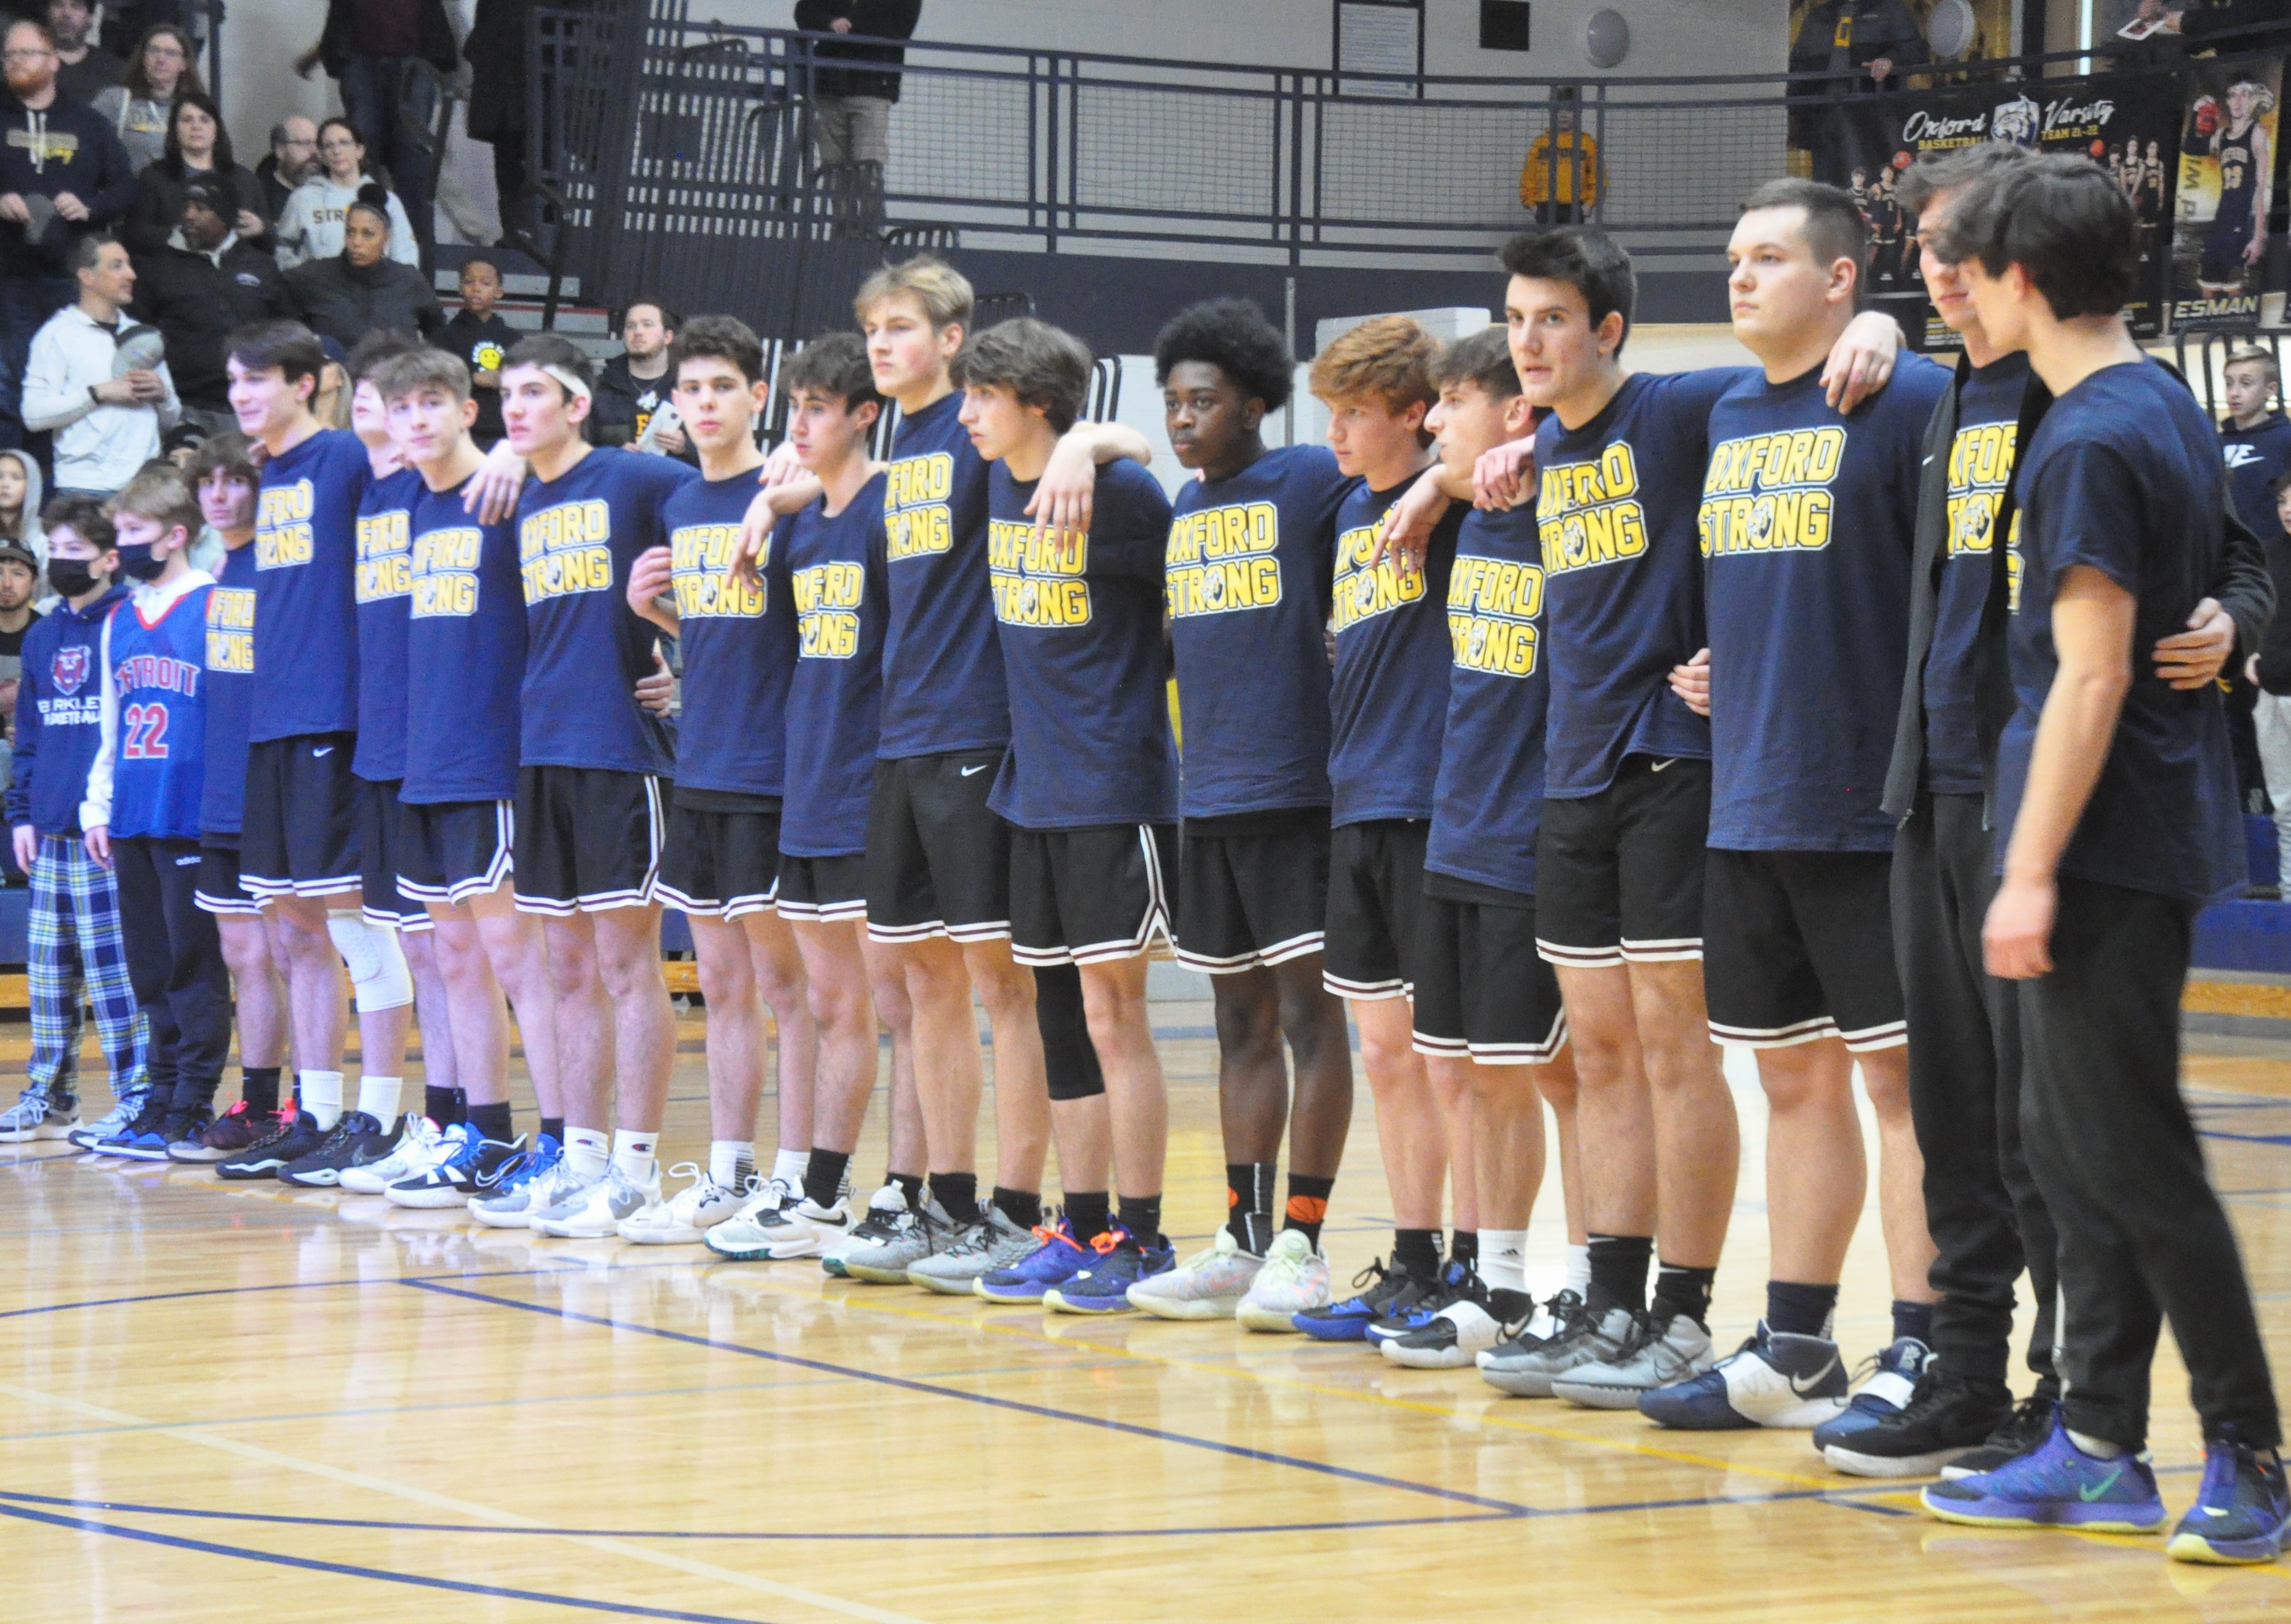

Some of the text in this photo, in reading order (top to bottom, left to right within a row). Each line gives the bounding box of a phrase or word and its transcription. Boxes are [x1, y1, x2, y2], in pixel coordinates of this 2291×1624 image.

[1903, 97, 2116, 142] Oxford Varsity
[1703, 426, 1847, 497] OXFORD
[1165, 501, 1279, 567] OXFORD
[1698, 488, 1834, 558] STRONG
[1165, 554, 1282, 620] STRONG
[123, 702, 169, 759] 22
